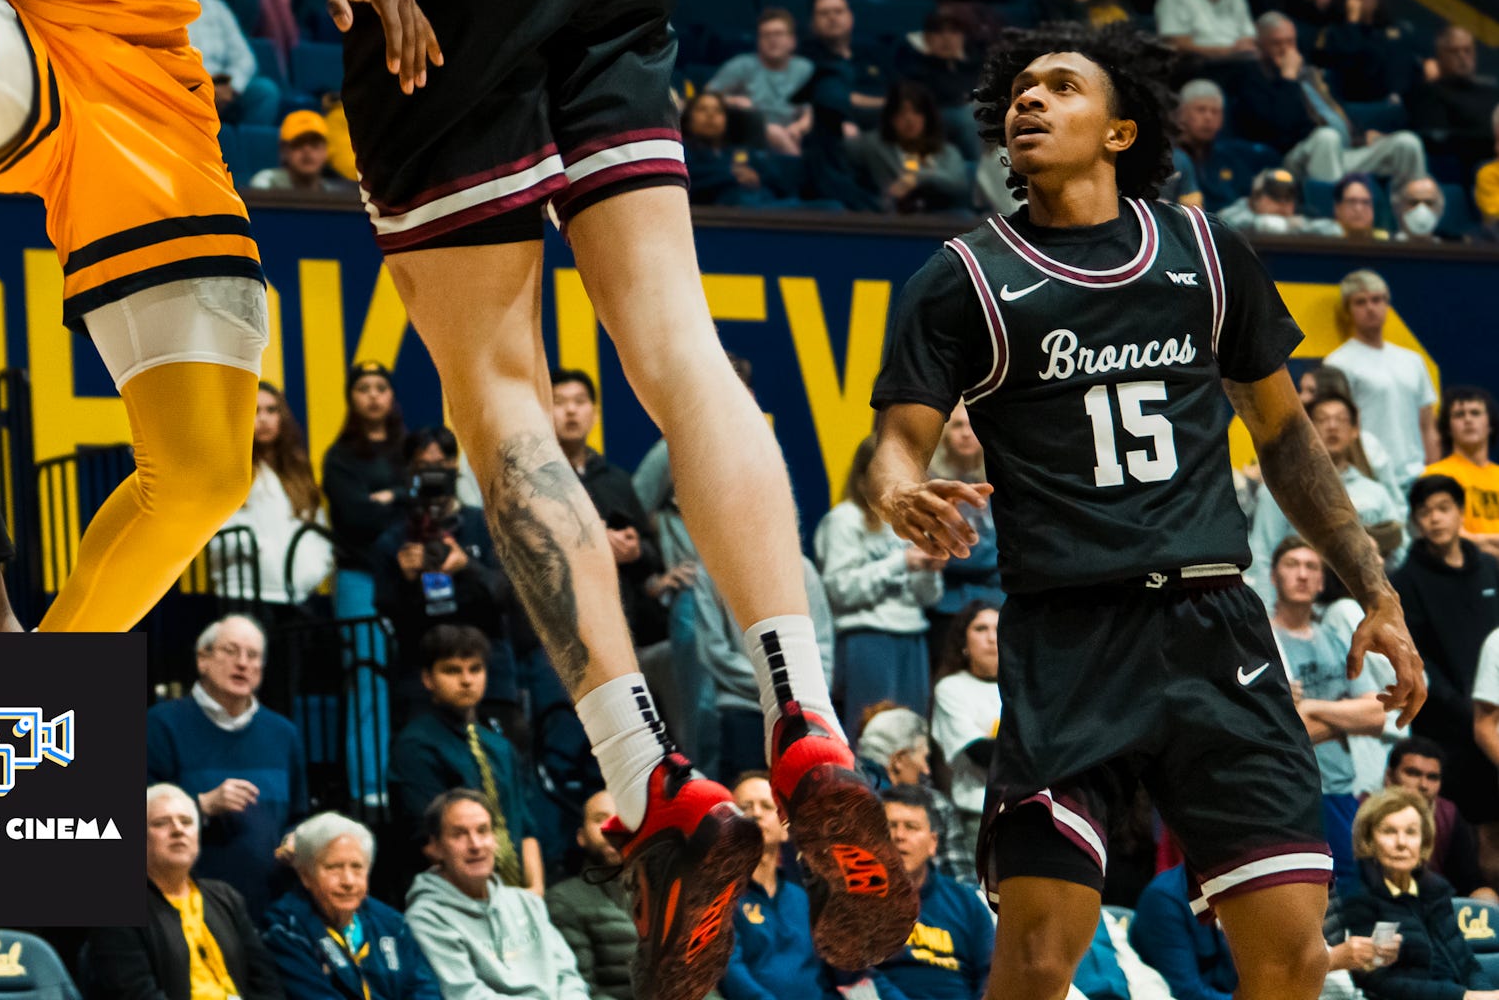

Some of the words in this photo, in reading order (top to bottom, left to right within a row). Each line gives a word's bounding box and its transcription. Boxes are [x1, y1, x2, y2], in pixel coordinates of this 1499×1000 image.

[1038, 328, 1197, 381] Broncos
[1084, 380, 1180, 488] 15
[1457, 905, 1497, 942] Cal
